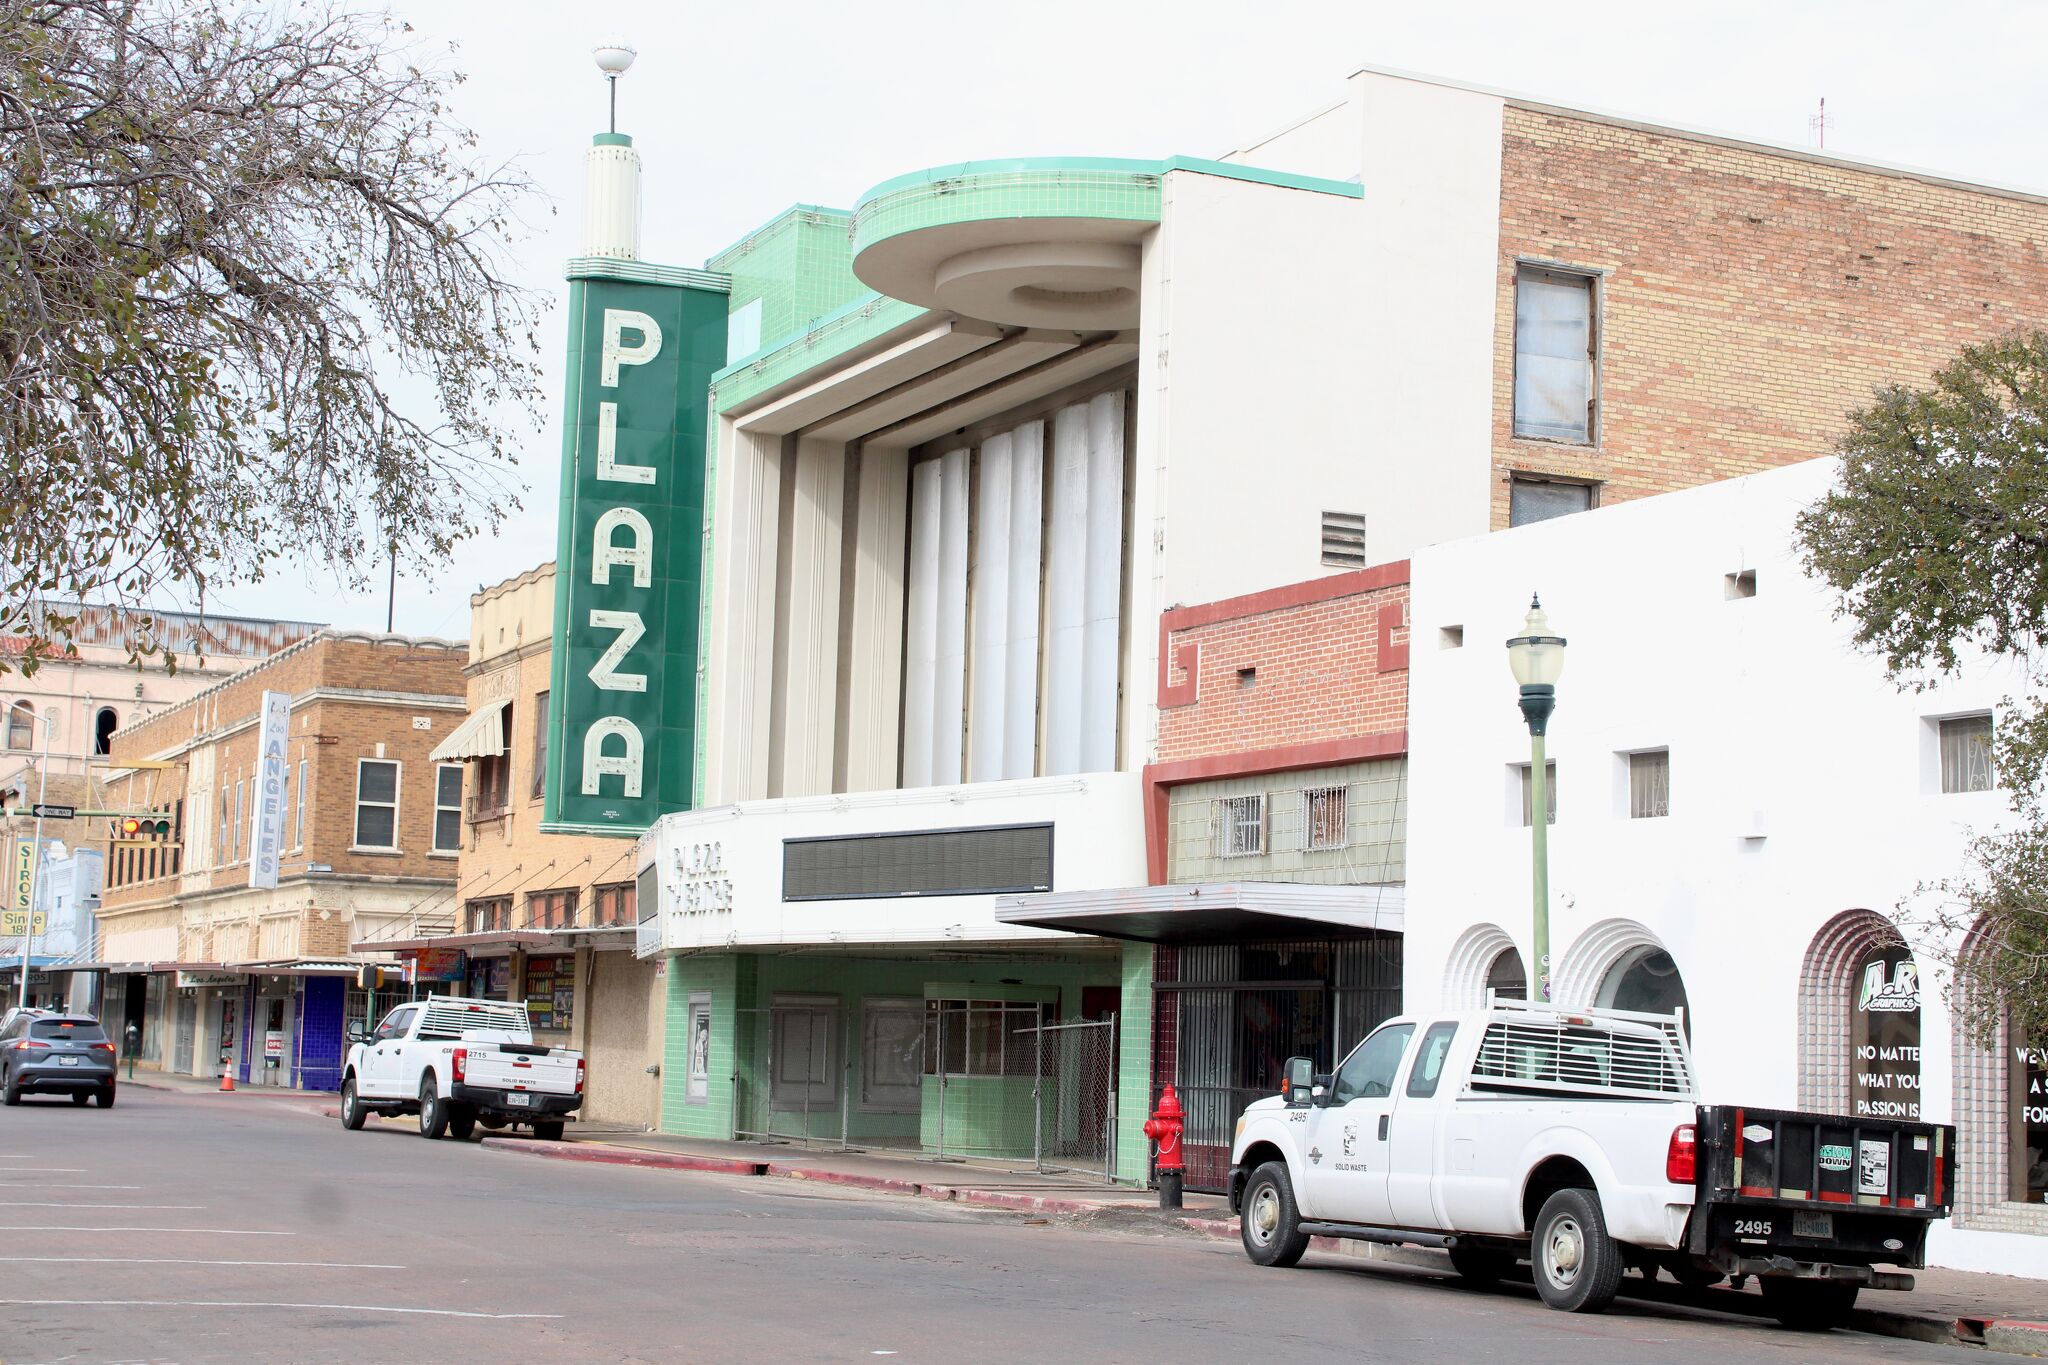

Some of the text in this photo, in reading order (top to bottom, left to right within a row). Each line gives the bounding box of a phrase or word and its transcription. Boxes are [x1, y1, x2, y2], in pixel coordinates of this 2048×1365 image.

[580, 308, 662, 798] PLAZA
[260, 739, 282, 874] ANGELES
[18, 845, 31, 906] SIROS
[5, 912, 42, 924] Sine
[1869, 997, 1916, 1010] GRAPHICS
[468, 1050, 487, 1059] 2715
[1857, 1045, 1920, 1061] NO MATTE
[1857, 1073, 1892, 1088] WHAT
[2030, 1077, 2041, 1094] A
[1857, 1100, 1906, 1117] PASSION
[1289, 1112, 1307, 1122] 2495
[1827, 1147, 1850, 1159] SLOW
[1335, 1163, 1367, 1172] SOLID WASTE
[1819, 1157, 1850, 1166] DOWN
[1734, 1220, 1772, 1235] 2495
